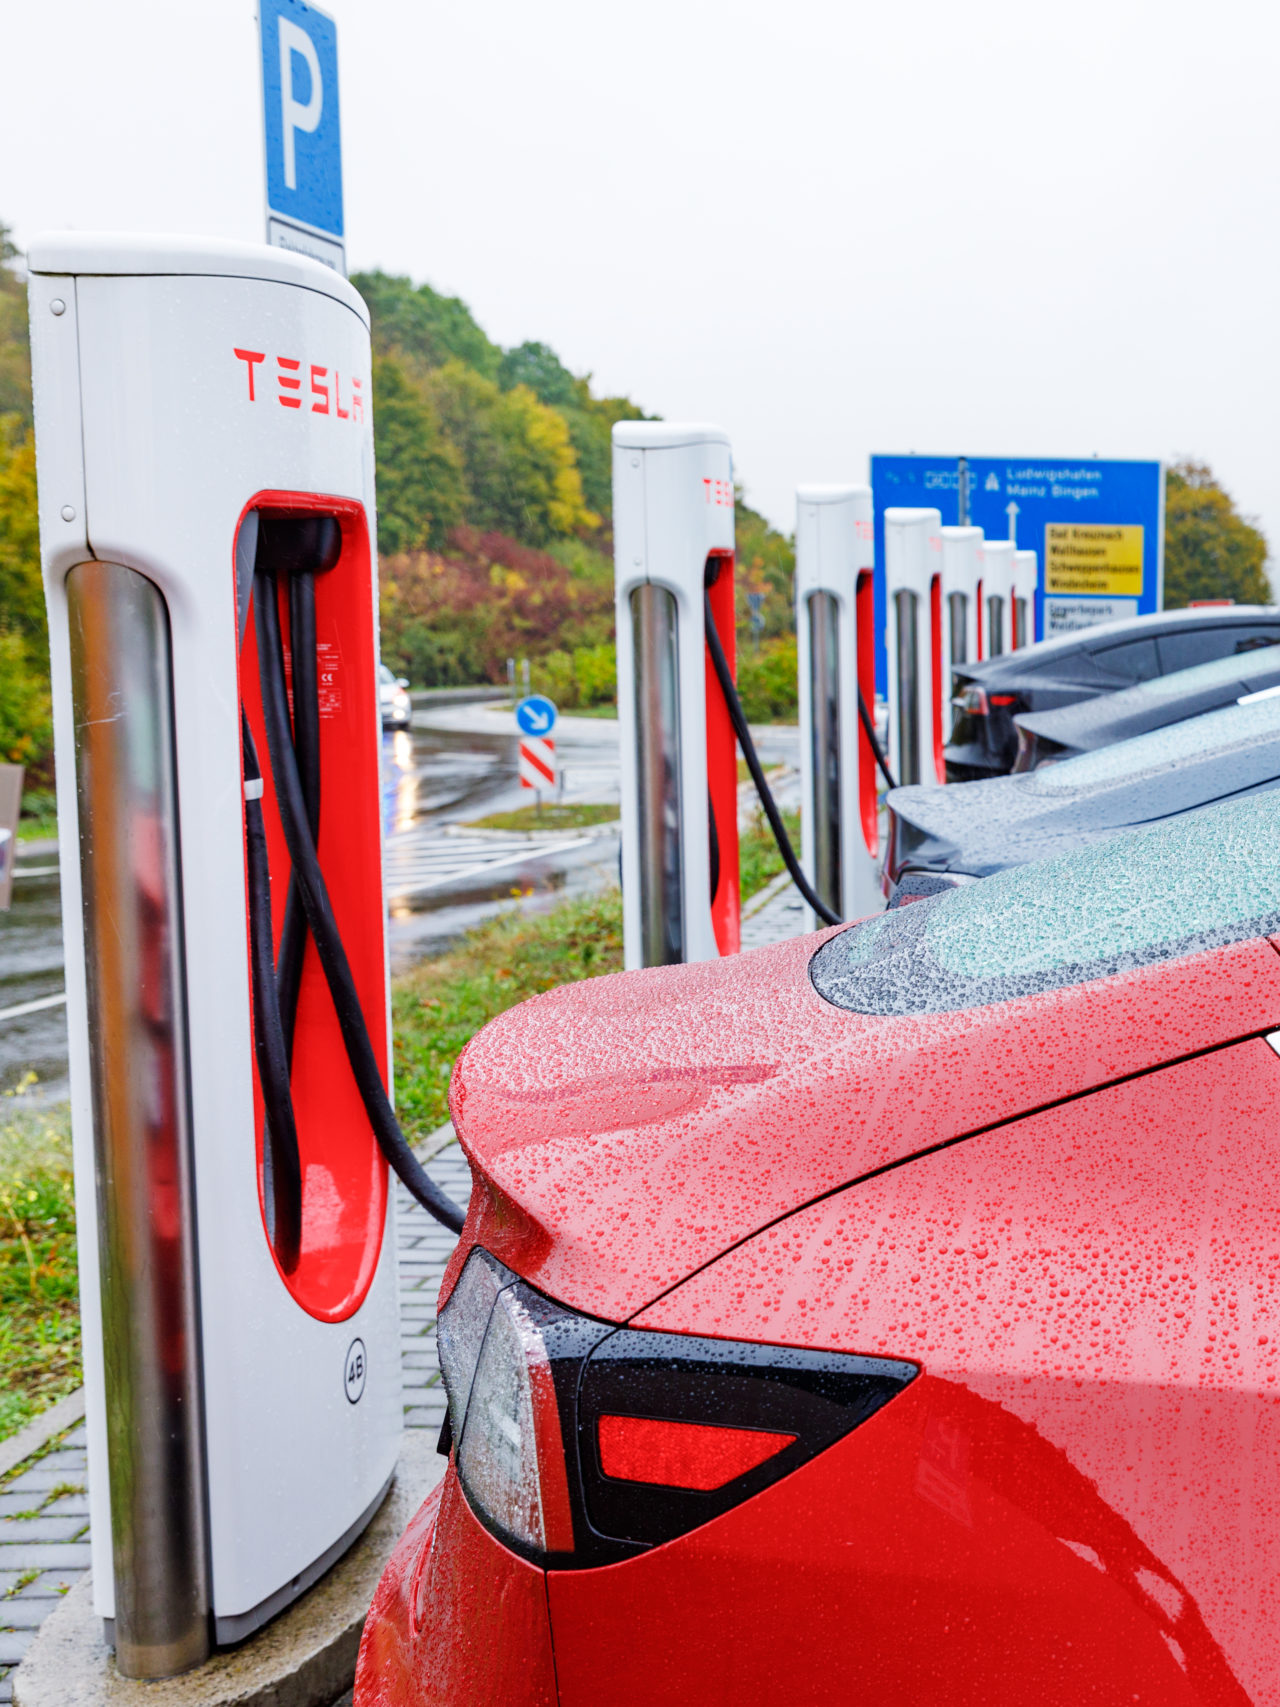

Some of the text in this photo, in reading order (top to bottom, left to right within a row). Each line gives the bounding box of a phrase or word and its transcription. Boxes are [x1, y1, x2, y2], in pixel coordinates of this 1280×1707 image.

[278, 15, 323, 190] P
[233, 347, 364, 425] TESLA
[1006, 467, 1102, 483] Ludwigshafen
[1006, 485, 1099, 501] Mainz Bingen
[348, 1354, 363, 1384] 4B
